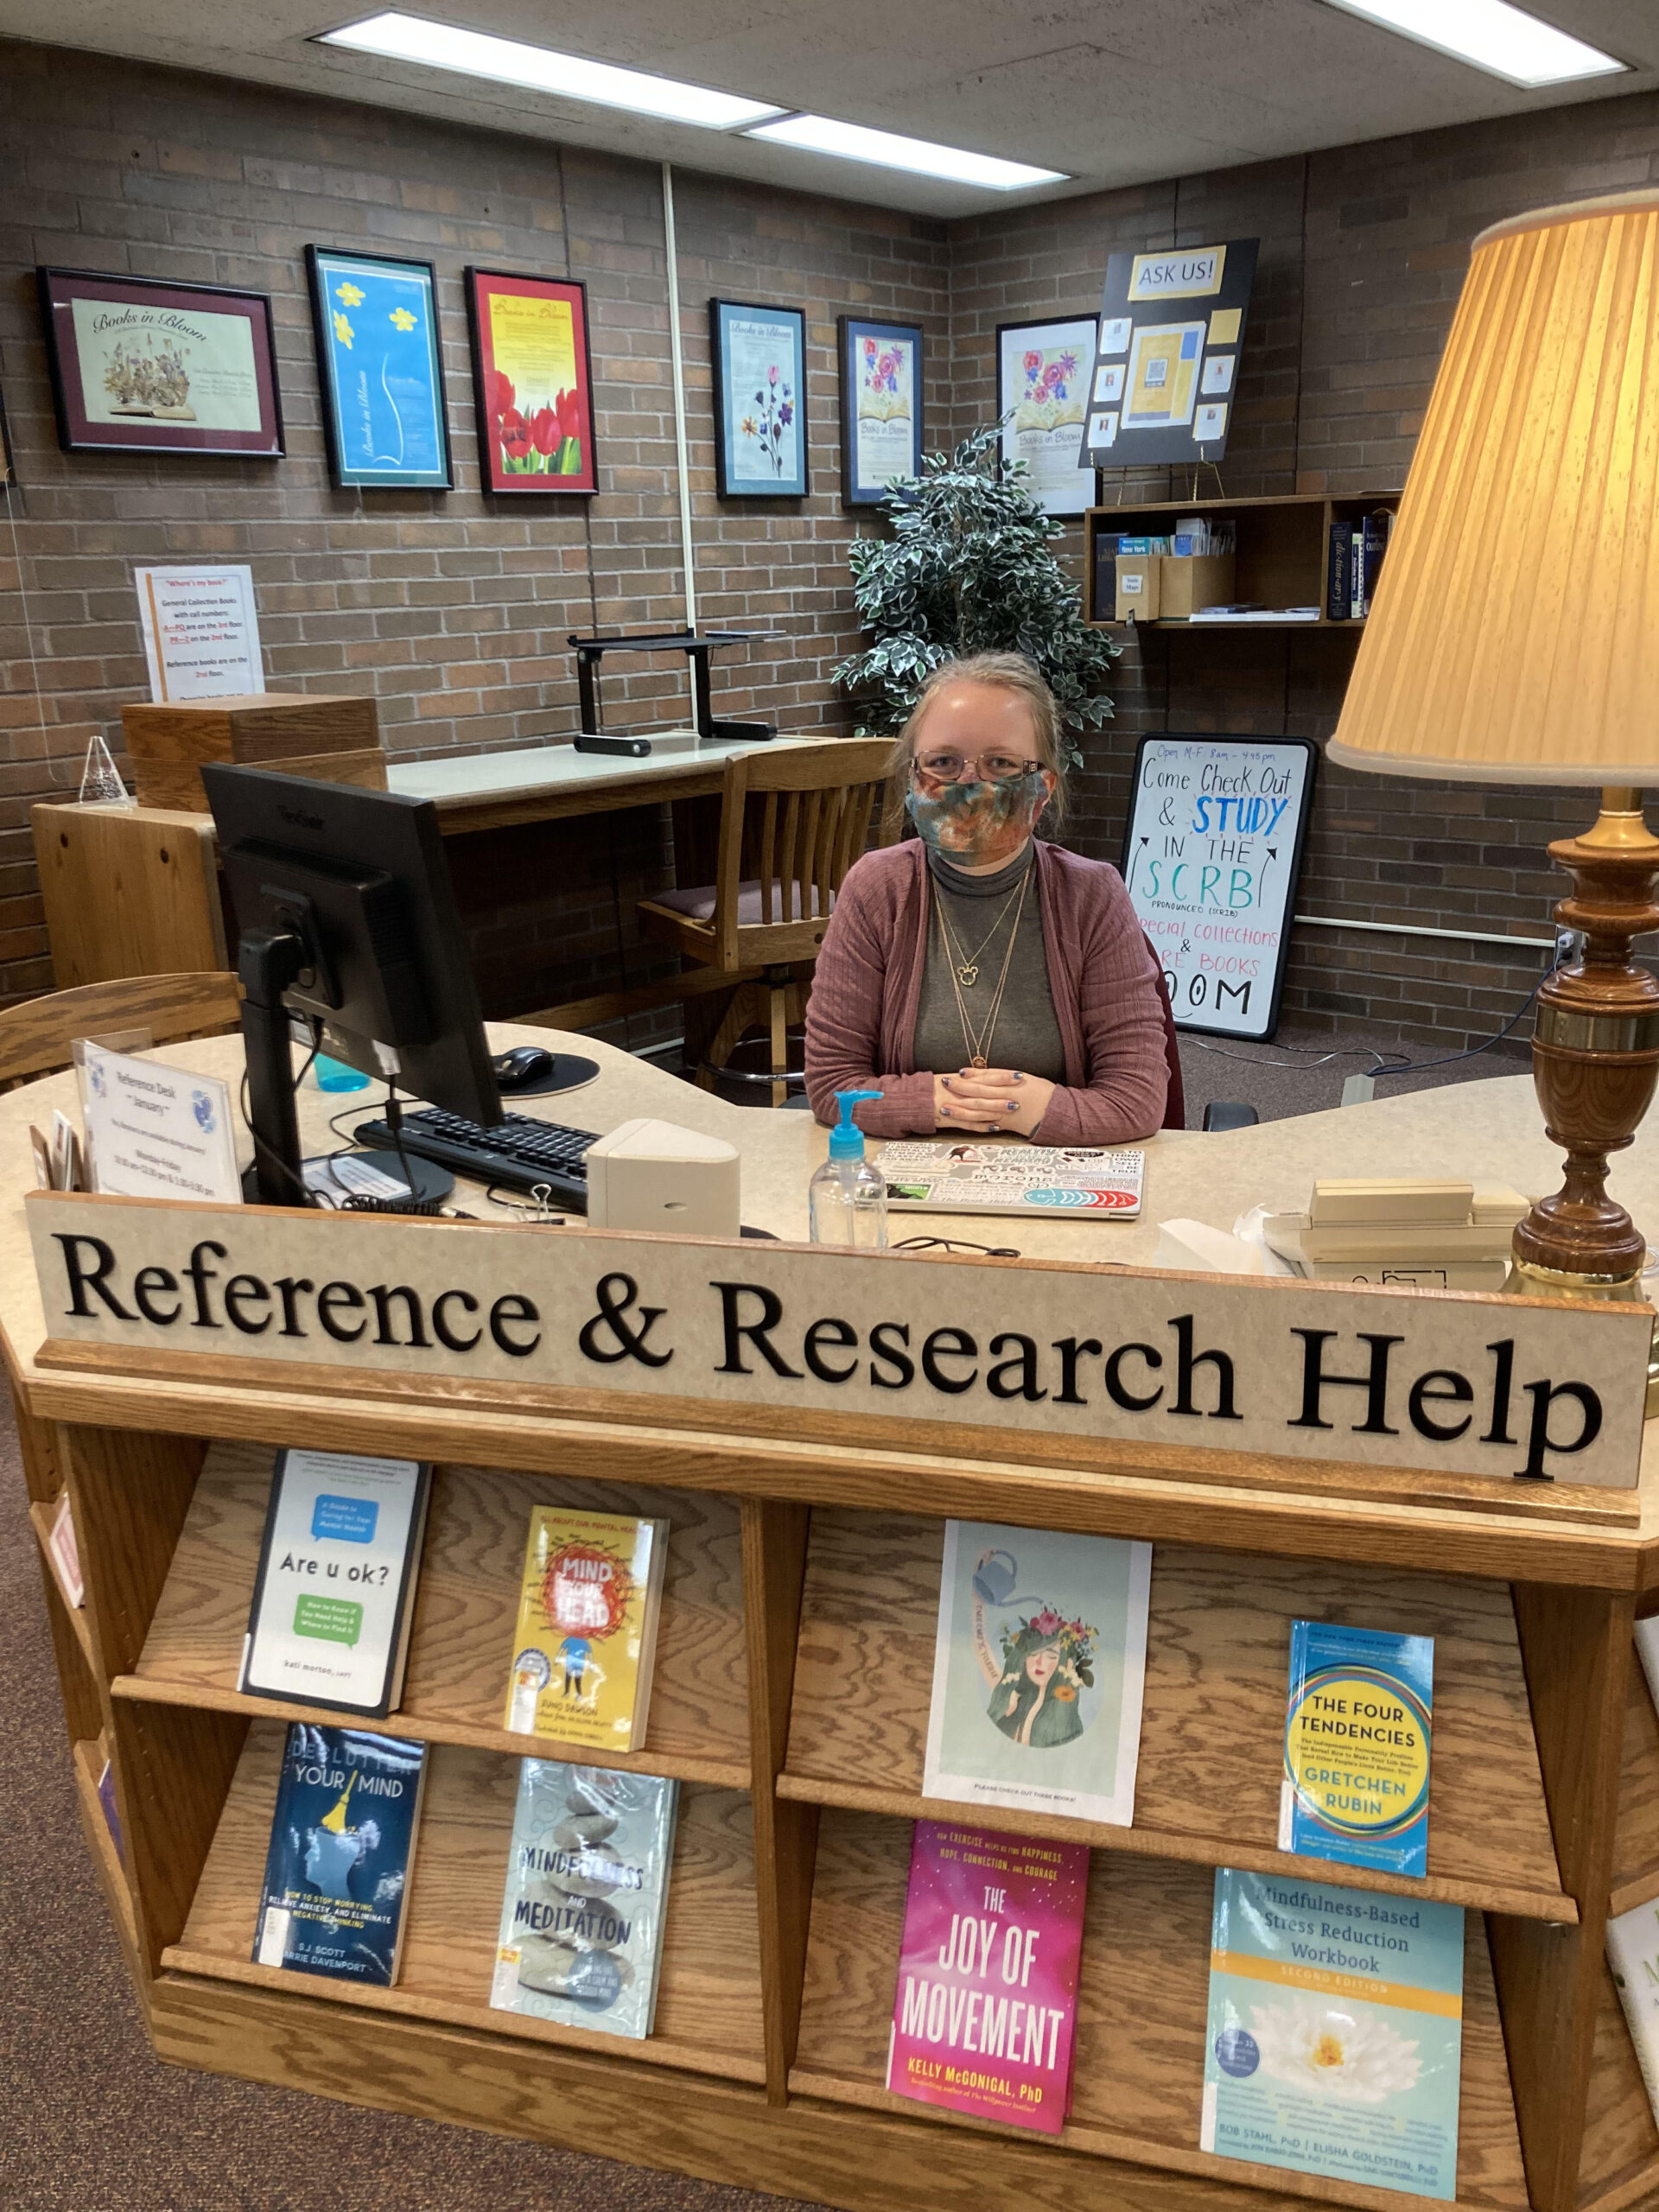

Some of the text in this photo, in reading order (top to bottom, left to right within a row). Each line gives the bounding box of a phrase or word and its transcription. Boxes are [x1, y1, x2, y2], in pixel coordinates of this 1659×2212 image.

[1139, 260, 1213, 285] ASK US!
[93, 308, 137, 334] Books
[141, 311, 154, 323] in
[158, 312, 207, 342] Bloom
[1020, 433, 1044, 446] Books
[1158, 745, 1178, 761] Open
[1143, 758, 1293, 794] Come Check Out
[1159, 796, 1288, 836] & STUDY
[1165, 836, 1254, 864] IN THE
[1142, 861, 1253, 909] SCRB
[1152, 900, 1204, 913] PRONOUNCED
[1140, 918, 1186, 938] pecial
[1180, 938, 1191, 953] &
[1200, 953, 1261, 977] BOOKS
[1164, 970, 1252, 1015] OOM
[117, 1071, 176, 1099] Reference Desk
[974, 1173, 1054, 1182] morons
[50, 1232, 1605, 1480] Reference & Research Help
[280, 1551, 390, 1586] Are u ok?
[563, 1557, 612, 1582] MIND
[557, 1597, 610, 1627] HEAD
[284, 1659, 301, 1669] kati
[1313, 1695, 1404, 1722] THE FOUR
[1300, 1716, 1415, 1747] TENDENCIES
[296, 1764, 403, 1798] YOUR MIND
[975, 1783, 997, 1792] PLEASE
[1305, 1767, 1406, 1796] GRETCHEN
[1325, 1793, 1382, 1815] RUBIN
[950, 1832, 1064, 1865] EXERCISE HAPPINESS,
[940, 1847, 1058, 1881] HOPE, CONNECTION, COURAGE
[269, 1895, 296, 1908] RELIEVE
[334, 1908, 349, 1917] AND
[352, 1910, 392, 1924] ELIMINATE
[314, 1896, 333, 1904] STOP
[567, 1896, 587, 1909] AND
[984, 1885, 1007, 1914] THE
[1255, 1887, 1421, 1929] Mindfulness-Based
[515, 1900, 632, 1944] MEDITATION
[1265, 1912, 1410, 1953] Stress Reduction
[283, 1952, 366, 1973] ARRIE DAVENPORT
[315, 1945, 346, 1958] SCOTT
[939, 1914, 1039, 1987] JOY OF
[1291, 1942, 1381, 1973] Workbook
[1281, 1965, 1331, 1983] SECOND
[1335, 1974, 1389, 1993] EDITION
[900, 1976, 1064, 2070] MOVEMENT
[908, 2057, 1043, 2103] KELLY McGONIGAL, PhD
[1219, 2123, 1240, 2135] BOB
[1313, 2142, 1349, 2158] ELISHA
[1352, 2151, 1413, 2172] GOLDSTEIN,
